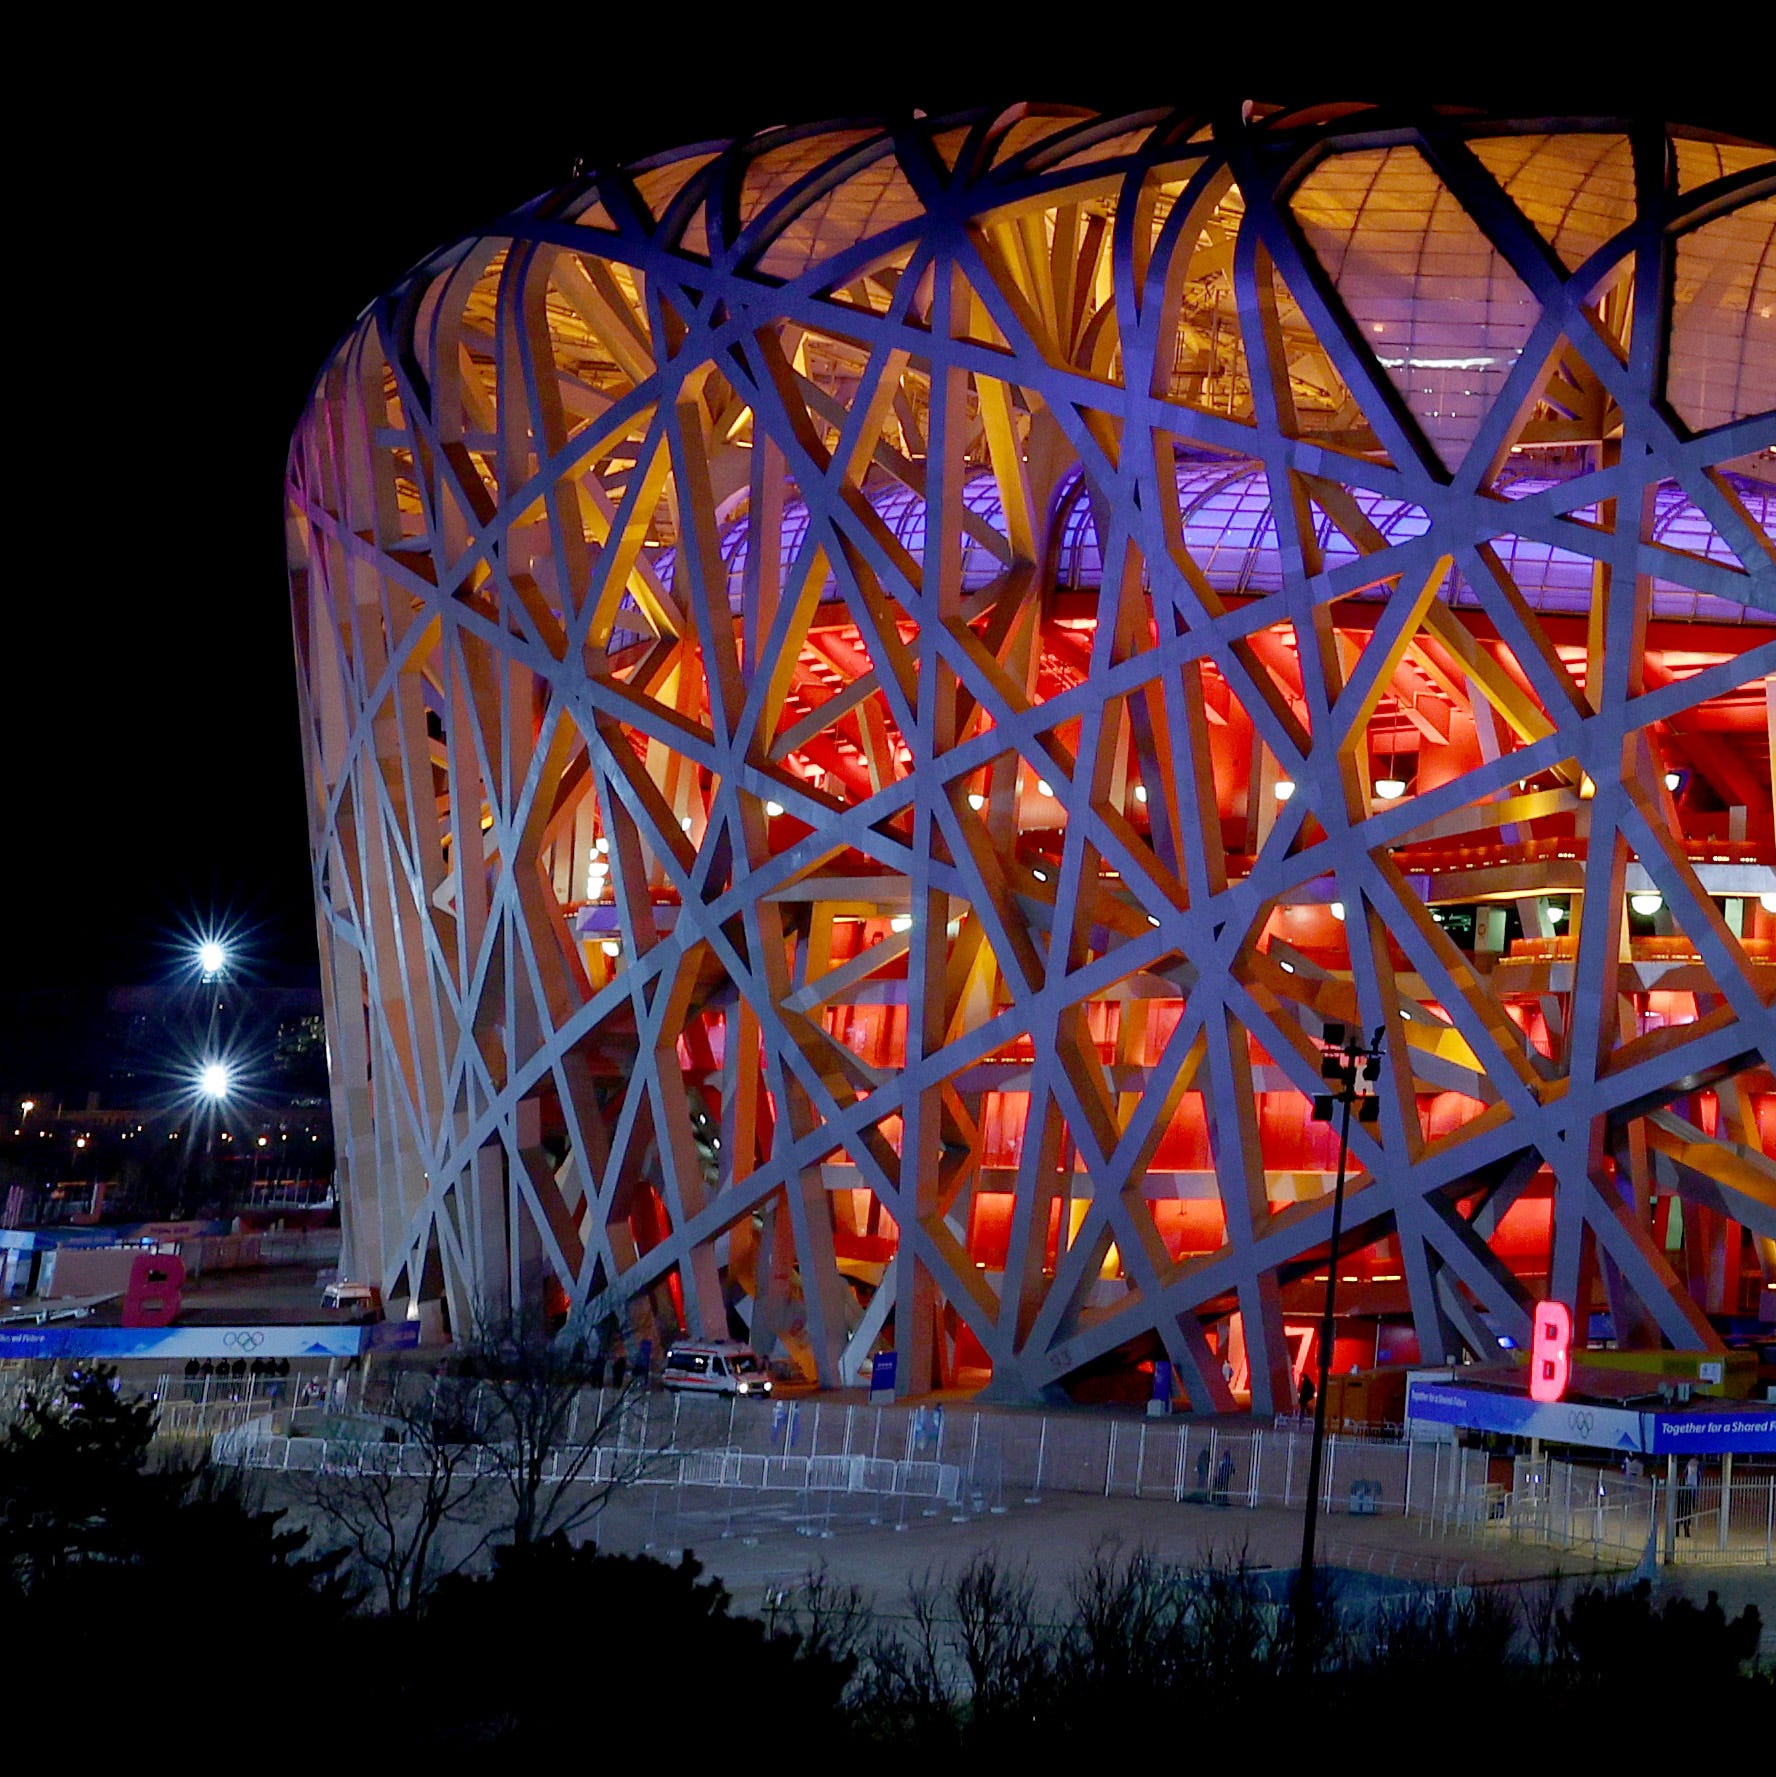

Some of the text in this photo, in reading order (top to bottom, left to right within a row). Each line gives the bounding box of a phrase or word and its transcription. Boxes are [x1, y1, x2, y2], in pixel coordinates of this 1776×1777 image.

[121, 1255, 187, 1328] B
[1530, 1300, 1574, 1403] B
[1662, 1422, 1706, 1436] Together
[1708, 1422, 1722, 1433] for
[1723, 1424, 1731, 1433] a
[1732, 1421, 1768, 1433] Shared
